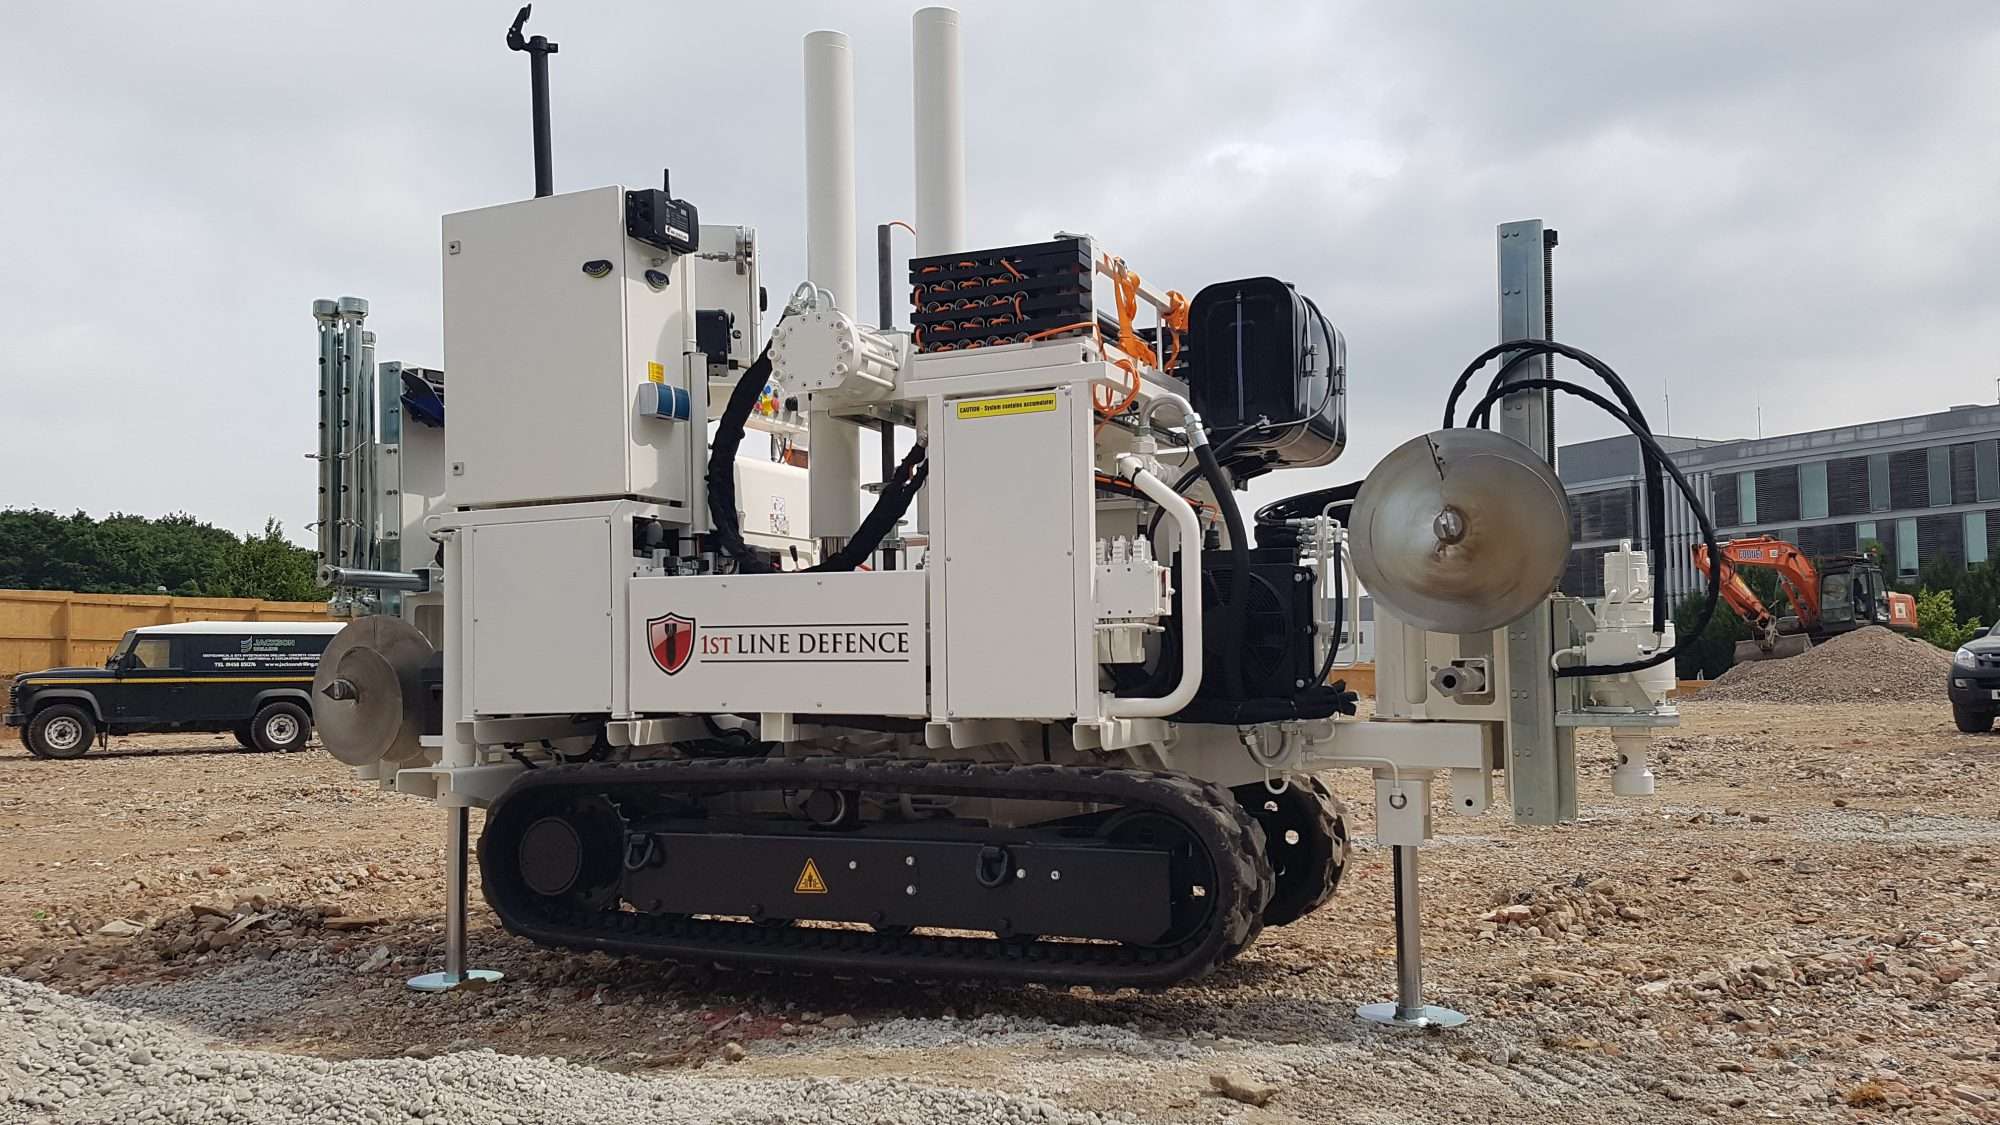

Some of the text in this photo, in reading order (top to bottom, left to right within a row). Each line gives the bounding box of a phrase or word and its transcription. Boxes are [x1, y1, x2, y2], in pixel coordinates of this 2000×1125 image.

[700, 632, 909, 655] 1ST LINE DEFENCE
